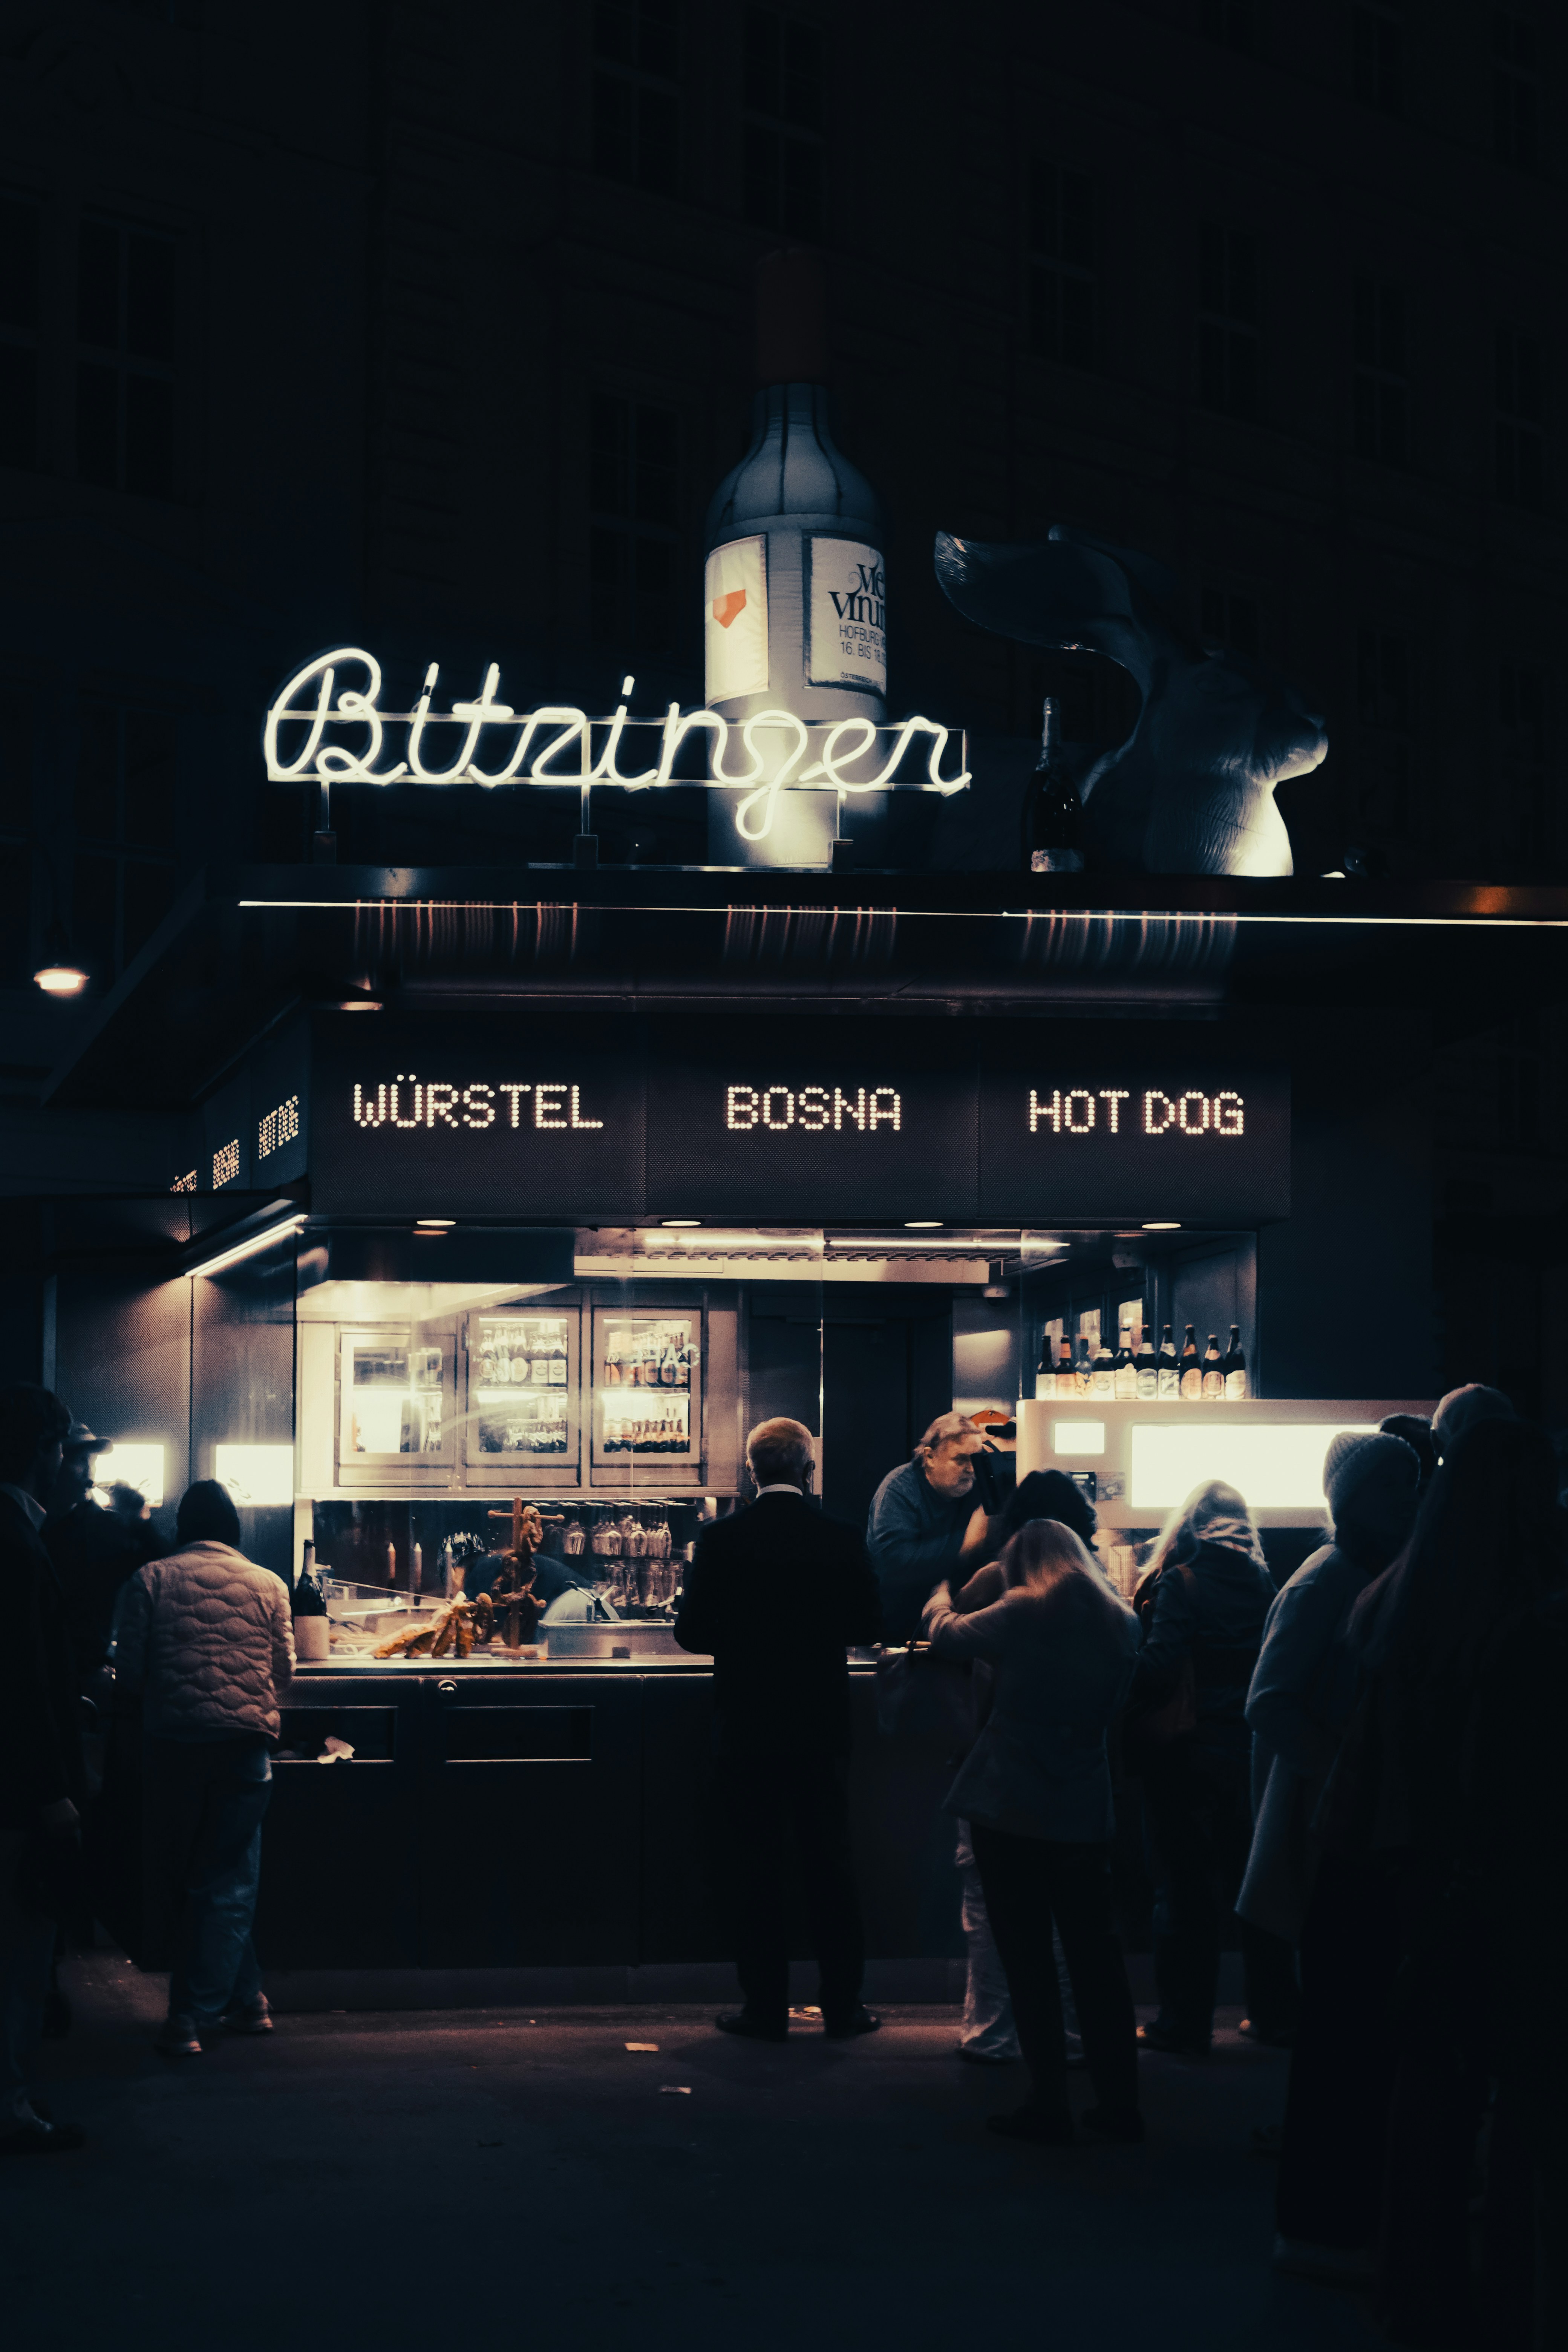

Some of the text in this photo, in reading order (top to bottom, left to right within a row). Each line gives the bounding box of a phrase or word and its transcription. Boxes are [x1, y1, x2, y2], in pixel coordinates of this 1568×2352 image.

[858, 643, 871, 659] BIS
[265, 648, 972, 841] Bitzinger
[354, 1074, 603, 1129] WÜRSTEL
[727, 1086, 901, 1131] BOSNA
[1029, 1090, 1244, 1135] HOT DOG
